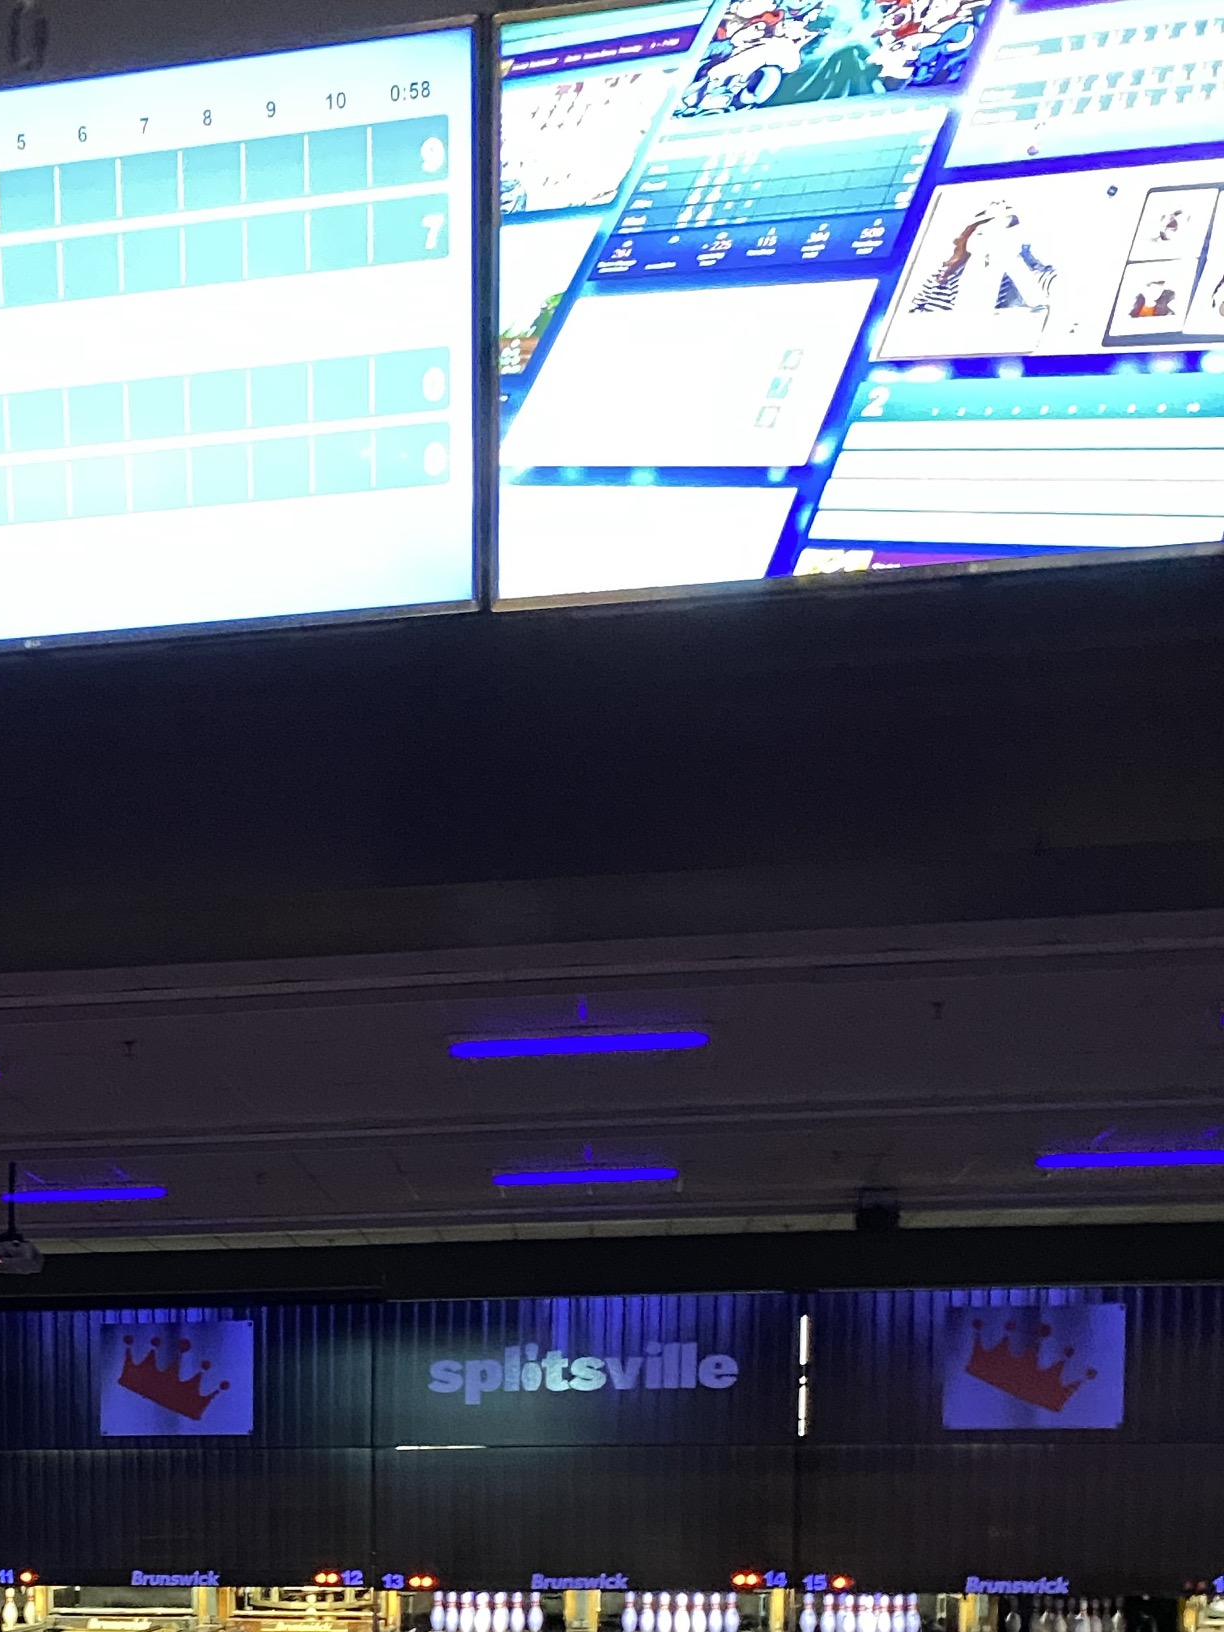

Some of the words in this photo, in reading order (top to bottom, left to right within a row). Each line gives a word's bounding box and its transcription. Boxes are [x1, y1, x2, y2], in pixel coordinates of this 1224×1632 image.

[16, 134, 26, 150] 5
[77, 126, 87, 142] 6
[139, 117, 149, 134] 7
[202, 109, 213, 126] 8
[265, 101, 276, 118] 9
[326, 92, 347, 110] 10
[390, 80, 431, 102] 0:58
[421, 213, 445, 250] 7
[861, 386, 891, 418] 2
[428, 1342, 739, 1405] splitsville
[131, 1570, 220, 1586] Brunswick
[341, 1569, 364, 1586] 12
[382, 1573, 405, 1590] 13
[531, 1573, 629, 1590] Brunswick
[764, 1570, 788, 1587] 14
[803, 1574, 828, 1592] 15
[965, 1576, 1070, 1595] Brunswick
